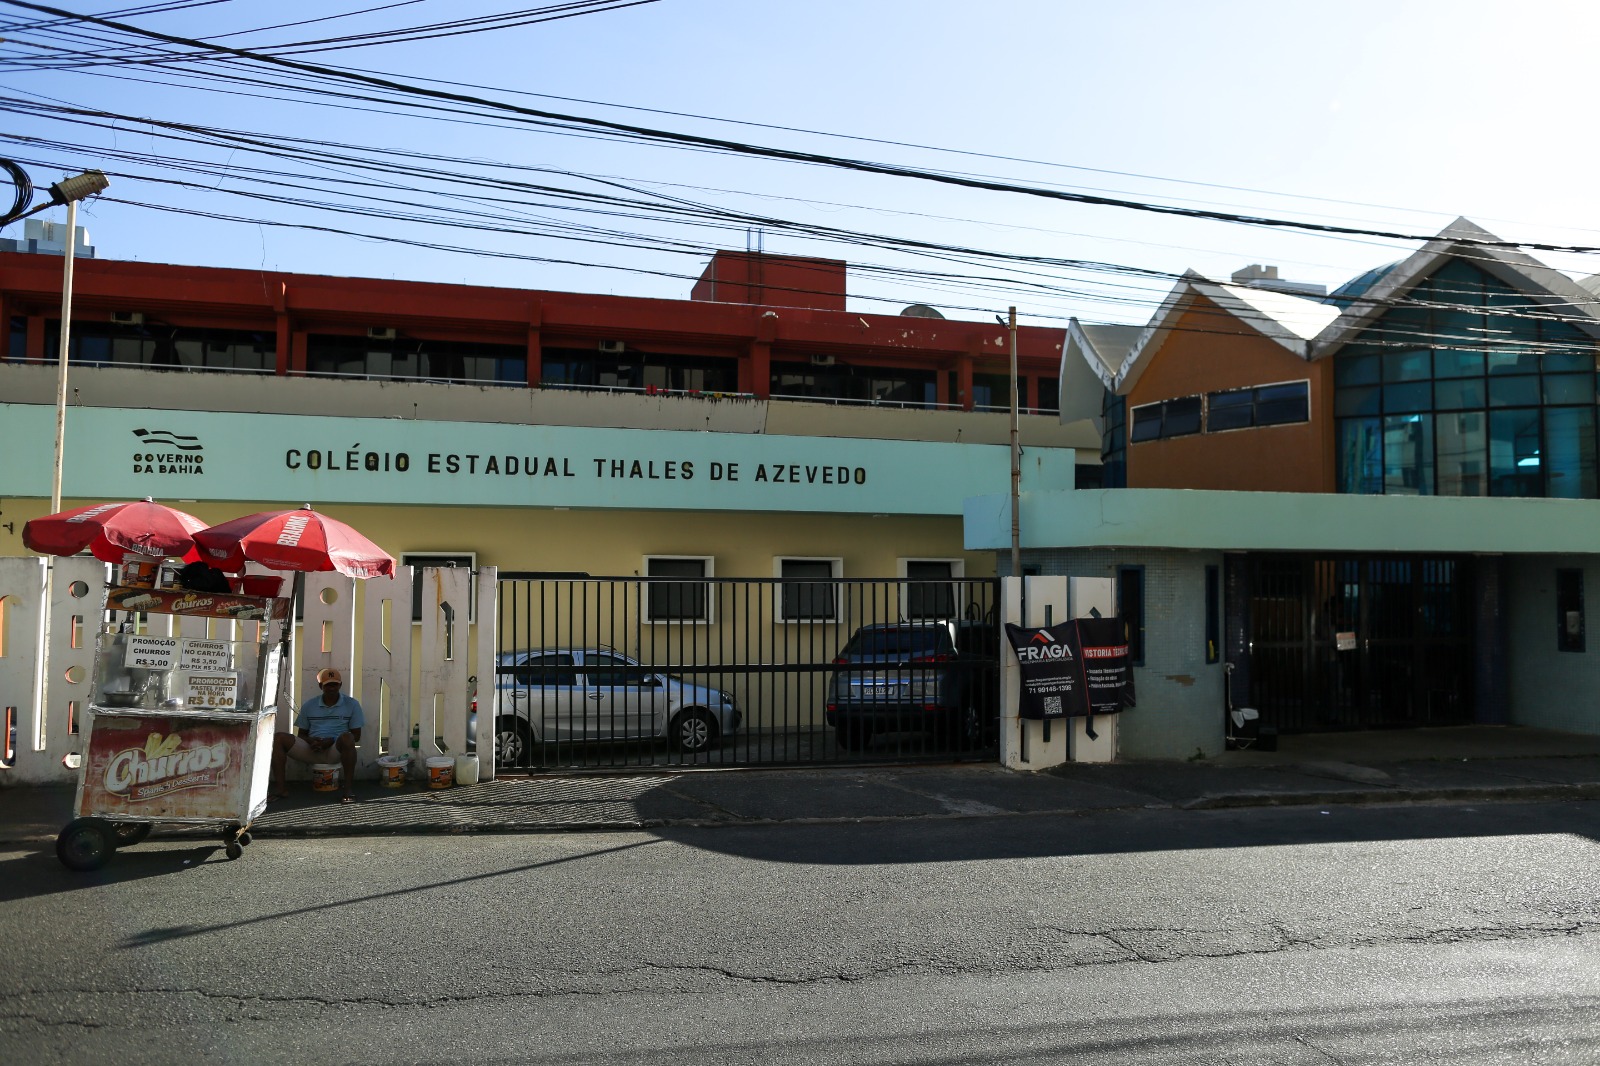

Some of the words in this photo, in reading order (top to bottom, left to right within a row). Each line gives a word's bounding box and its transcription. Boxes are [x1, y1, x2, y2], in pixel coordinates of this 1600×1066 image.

[133, 453, 204, 464] GOVERNO
[286, 442, 410, 472] COLÉGIO
[428, 453, 576, 477] ESTADUAL
[594, 458, 694, 480] THALES
[710, 462, 739, 482] DE
[754, 464, 866, 485] AZEVEDO
[134, 464, 156, 474] DA
[158, 464, 204, 475] BAHIA
[131, 543, 164, 556] BRAHMA
[171, 598, 213, 611] Churros
[132, 638, 176, 647] PROMOÇÃO
[1017, 644, 1073, 660] FRAGA
[1084, 648, 1112, 658] VISTORIA
[150, 659, 168, 667] 3,00
[188, 696, 204, 705] R$
[207, 697, 234, 707] 6,00
[106, 743, 227, 792] Churros
[172, 774, 210, 788] Desserts
